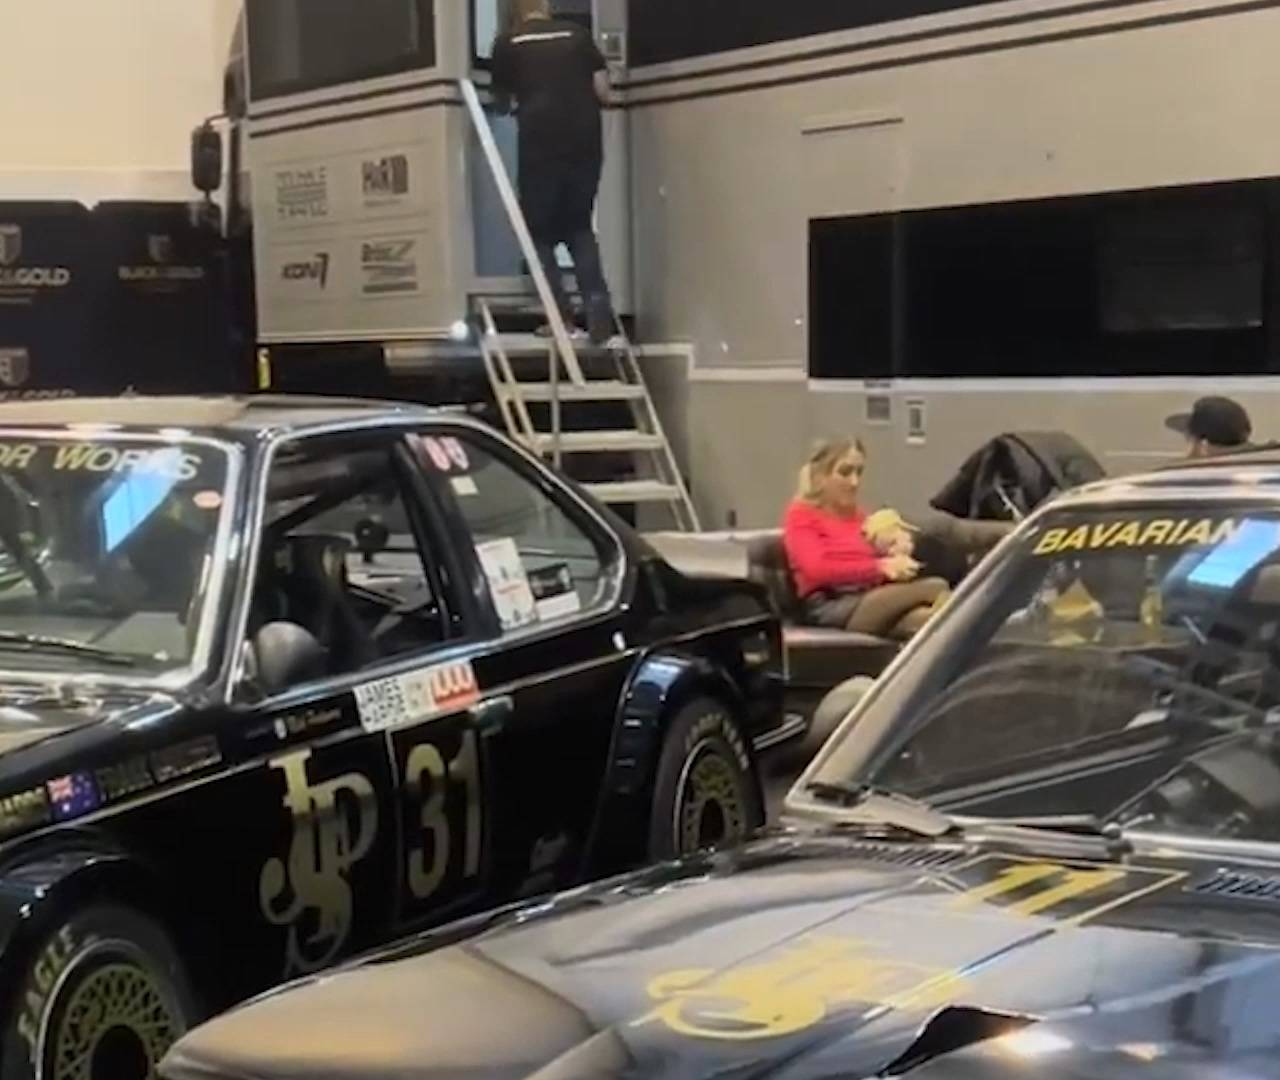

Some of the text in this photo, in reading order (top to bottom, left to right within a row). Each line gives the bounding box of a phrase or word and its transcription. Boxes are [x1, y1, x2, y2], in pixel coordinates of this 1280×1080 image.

[1031, 518, 1244, 556] BAVARIAN
[406, 730, 482, 899] 31
[948, 861, 1124, 917] 11
